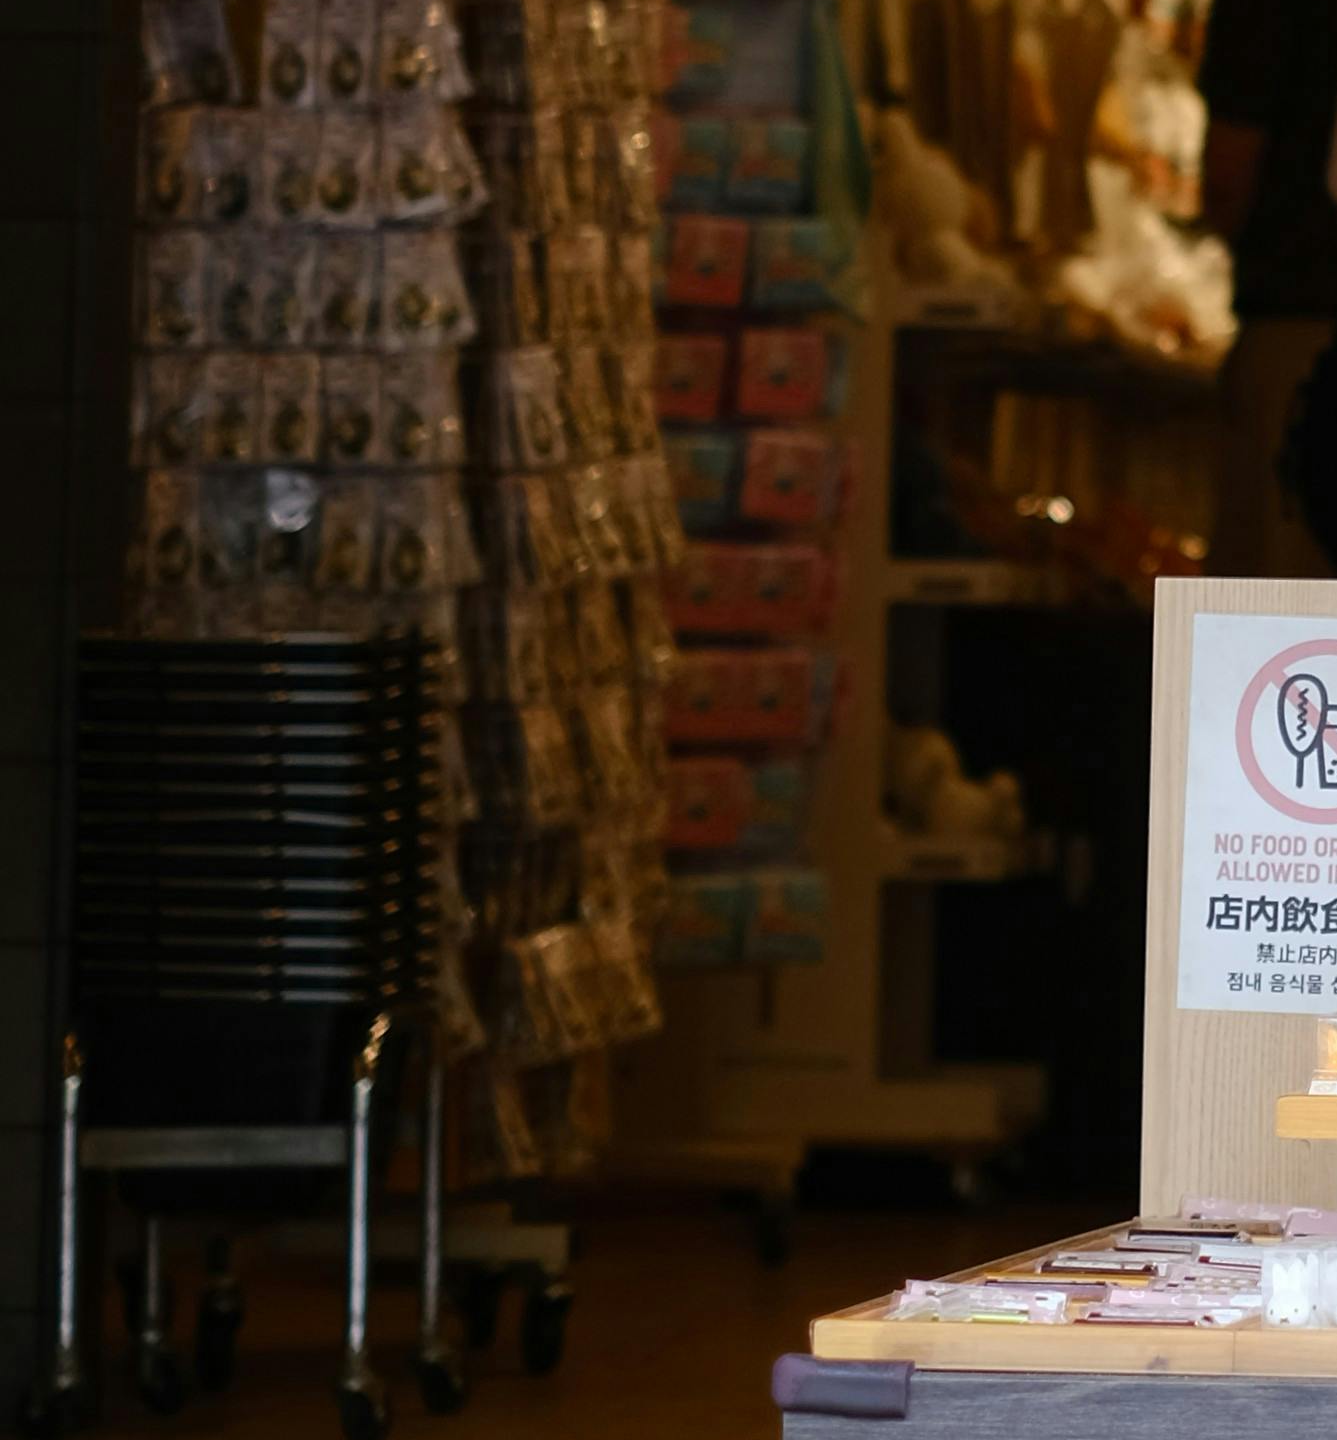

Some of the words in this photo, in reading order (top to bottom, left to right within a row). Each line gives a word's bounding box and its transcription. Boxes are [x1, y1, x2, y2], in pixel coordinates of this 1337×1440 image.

[1214, 833, 1243, 854] NO
[1251, 835, 1307, 857] FOOD
[1216, 861, 1320, 884] ALLOWED
[1227, 972, 1261, 992] 점내
[1269, 974, 1324, 994] 음식물
